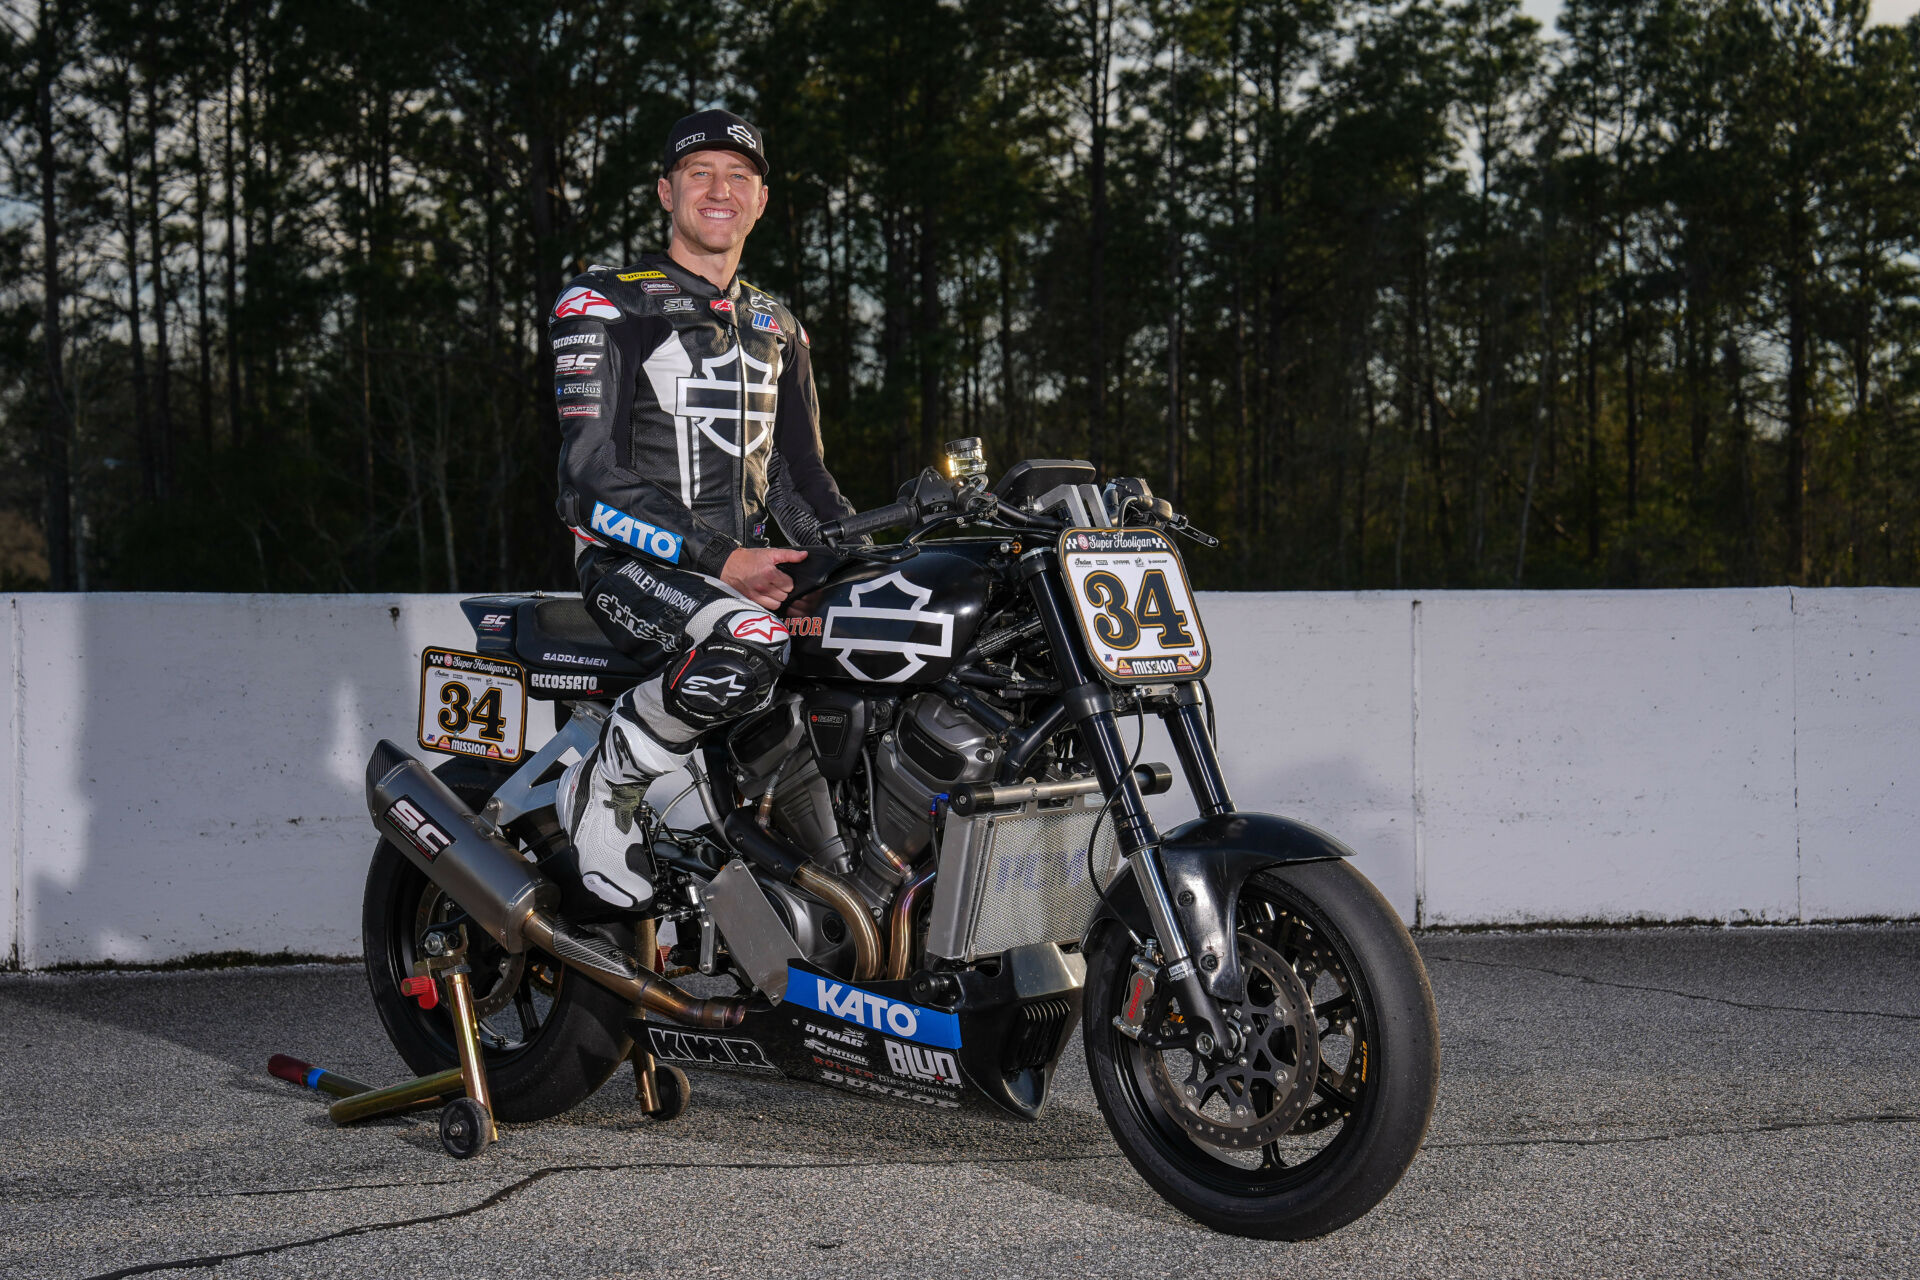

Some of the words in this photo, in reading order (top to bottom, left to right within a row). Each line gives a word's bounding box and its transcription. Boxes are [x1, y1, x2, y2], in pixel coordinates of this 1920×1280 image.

[557, 354, 602, 368] SC
[563, 383, 601, 394] excelsus
[591, 503, 677, 558] KATO
[1089, 535, 1113, 551] Super
[1113, 532, 1152, 552] Hooligan
[481, 614, 511, 625] SC
[1083, 569, 1195, 651] 34
[780, 616, 823, 637] ATOR
[453, 656, 473, 669] Super
[473, 659, 504, 674] Hooligan
[542, 653, 609, 667] SADDLEMEN
[531, 673, 598, 690] ACCOSSATO
[438, 681, 506, 742] 34
[451, 739, 487, 755] MISSION
[390, 799, 451, 854] SC
[817, 979, 917, 1037] KATO
[804, 1023, 863, 1047] DYMAG
[648, 1028, 777, 1070] KWR
[813, 1056, 874, 1079] ROLLER
[821, 1070, 961, 1108] DUNLOP
